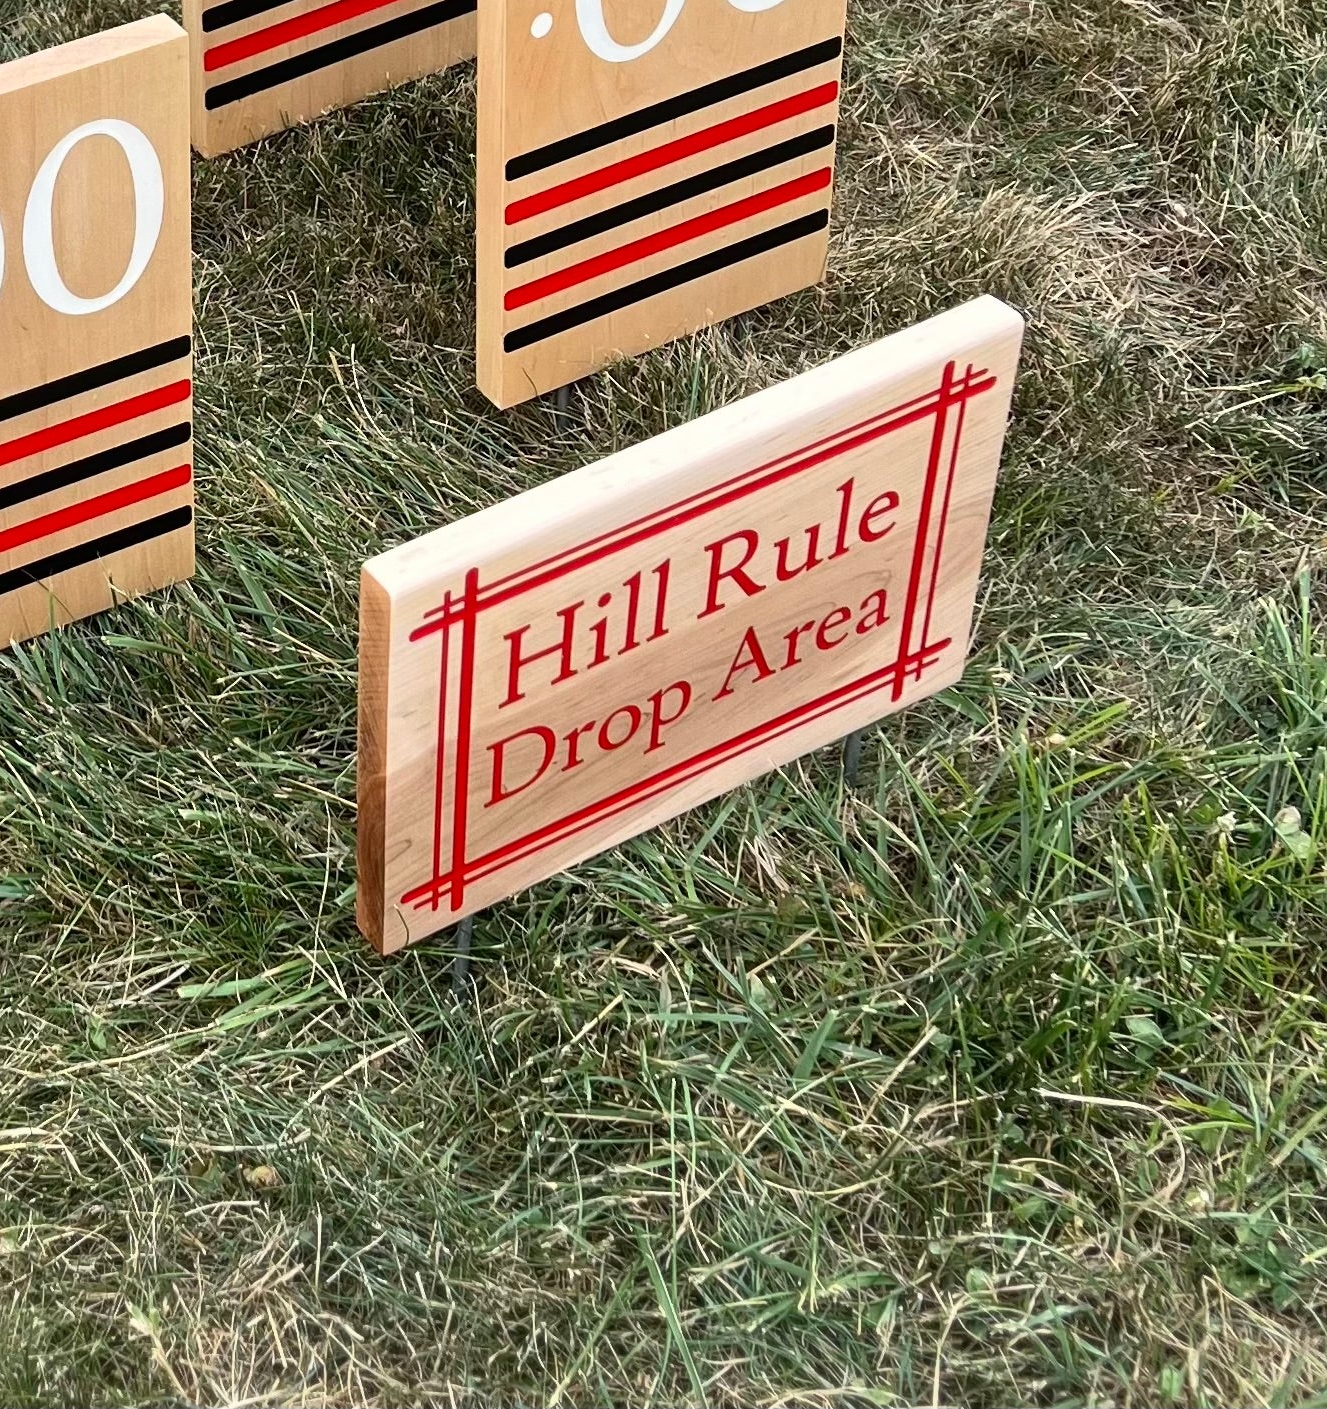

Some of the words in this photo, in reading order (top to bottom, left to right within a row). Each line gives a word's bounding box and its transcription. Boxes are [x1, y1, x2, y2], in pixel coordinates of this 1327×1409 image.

[484, 678, 691, 808] Drop
[712, 586, 890, 701] Area
[498, 556, 672, 709] Hill
[697, 476, 900, 619] Rule
